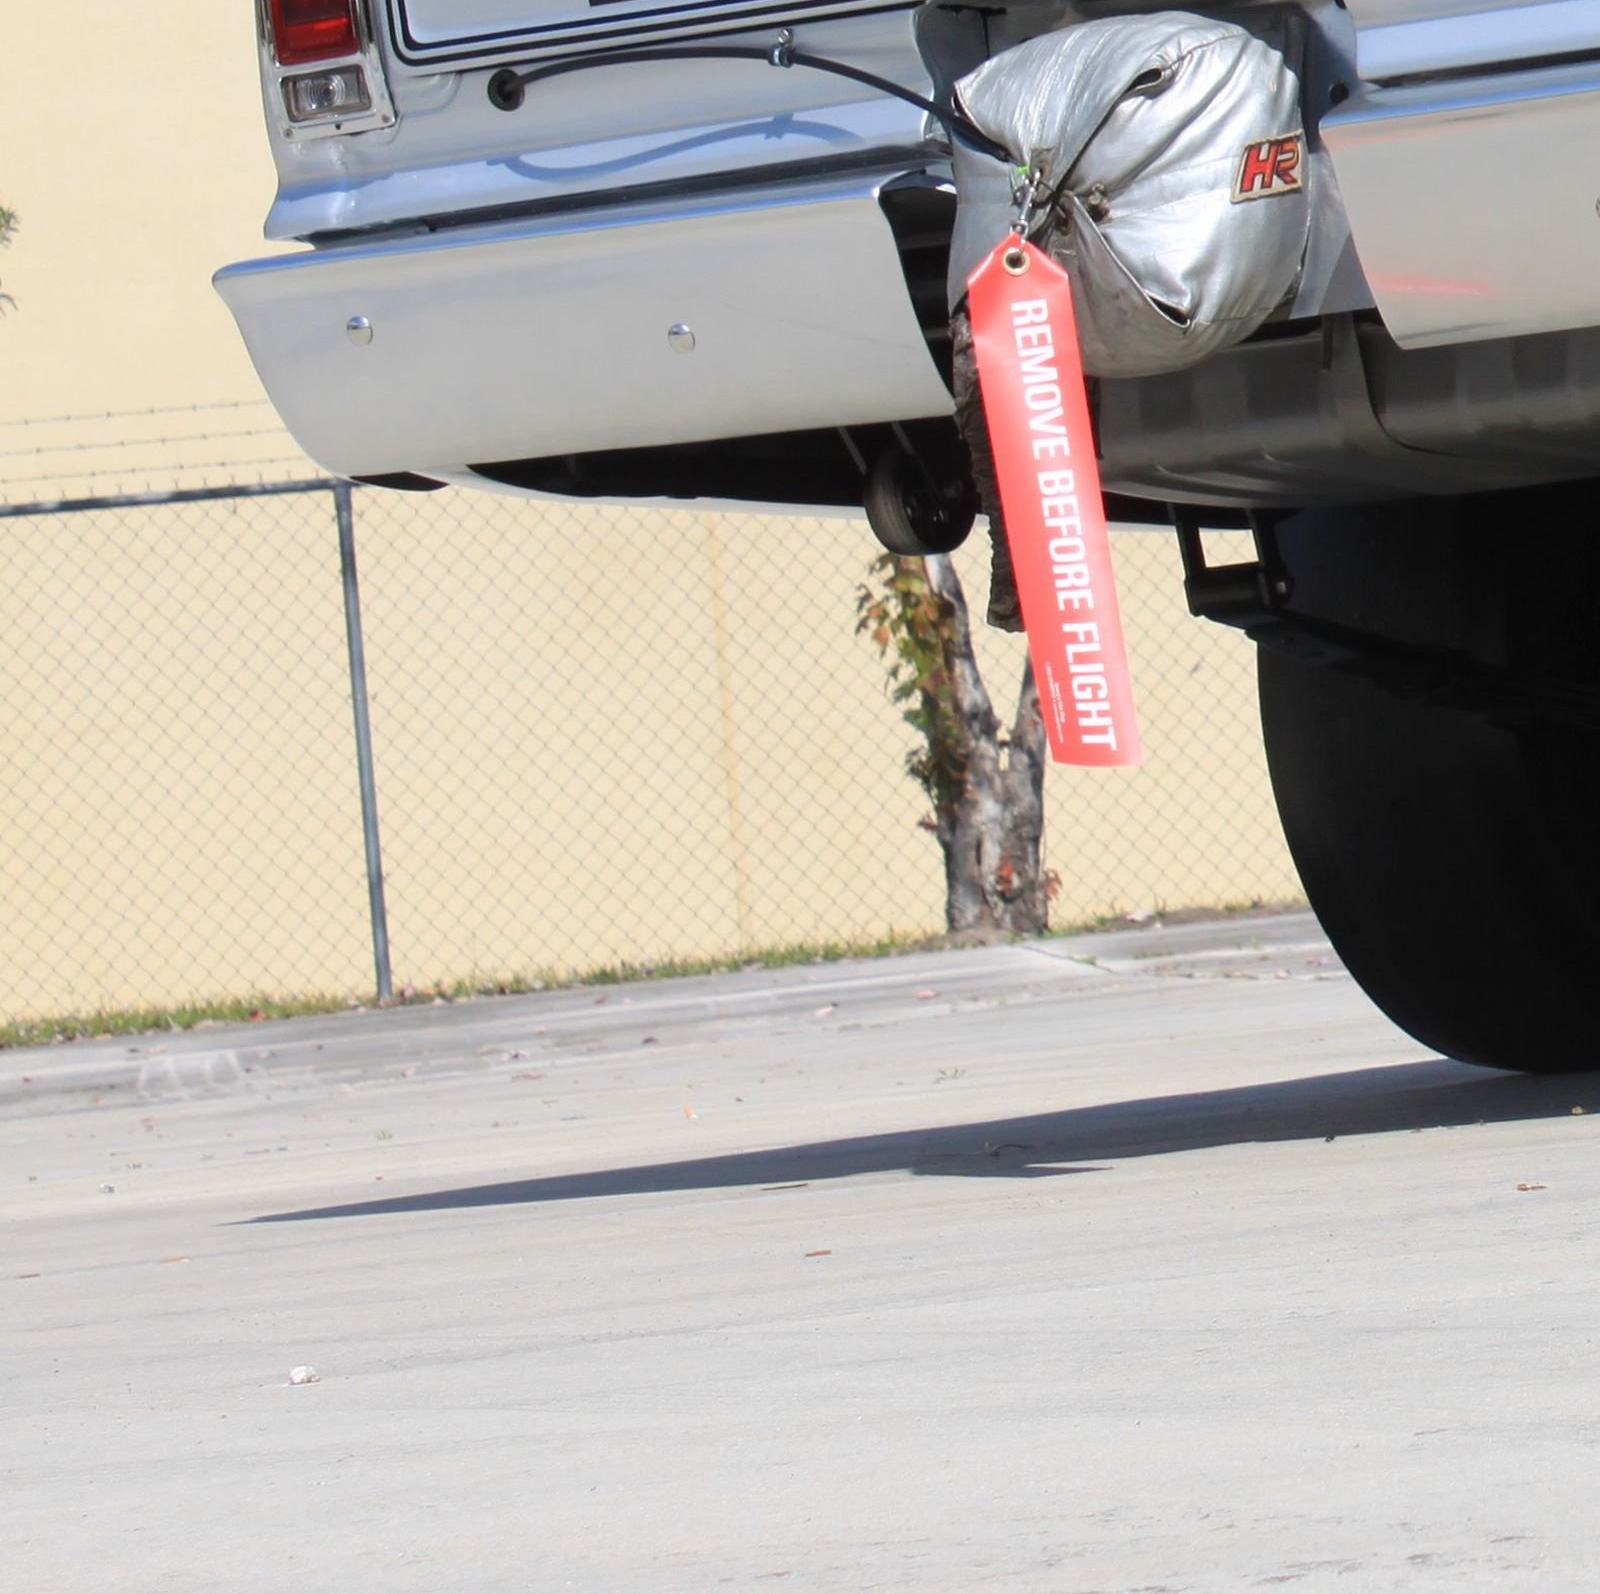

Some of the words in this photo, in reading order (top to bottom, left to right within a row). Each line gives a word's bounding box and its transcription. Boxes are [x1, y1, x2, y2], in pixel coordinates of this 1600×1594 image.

[1011, 298, 1070, 460] REMOVE
[1037, 468, 1093, 611] BEFORE
[1062, 620, 1117, 755] FLIGHT
